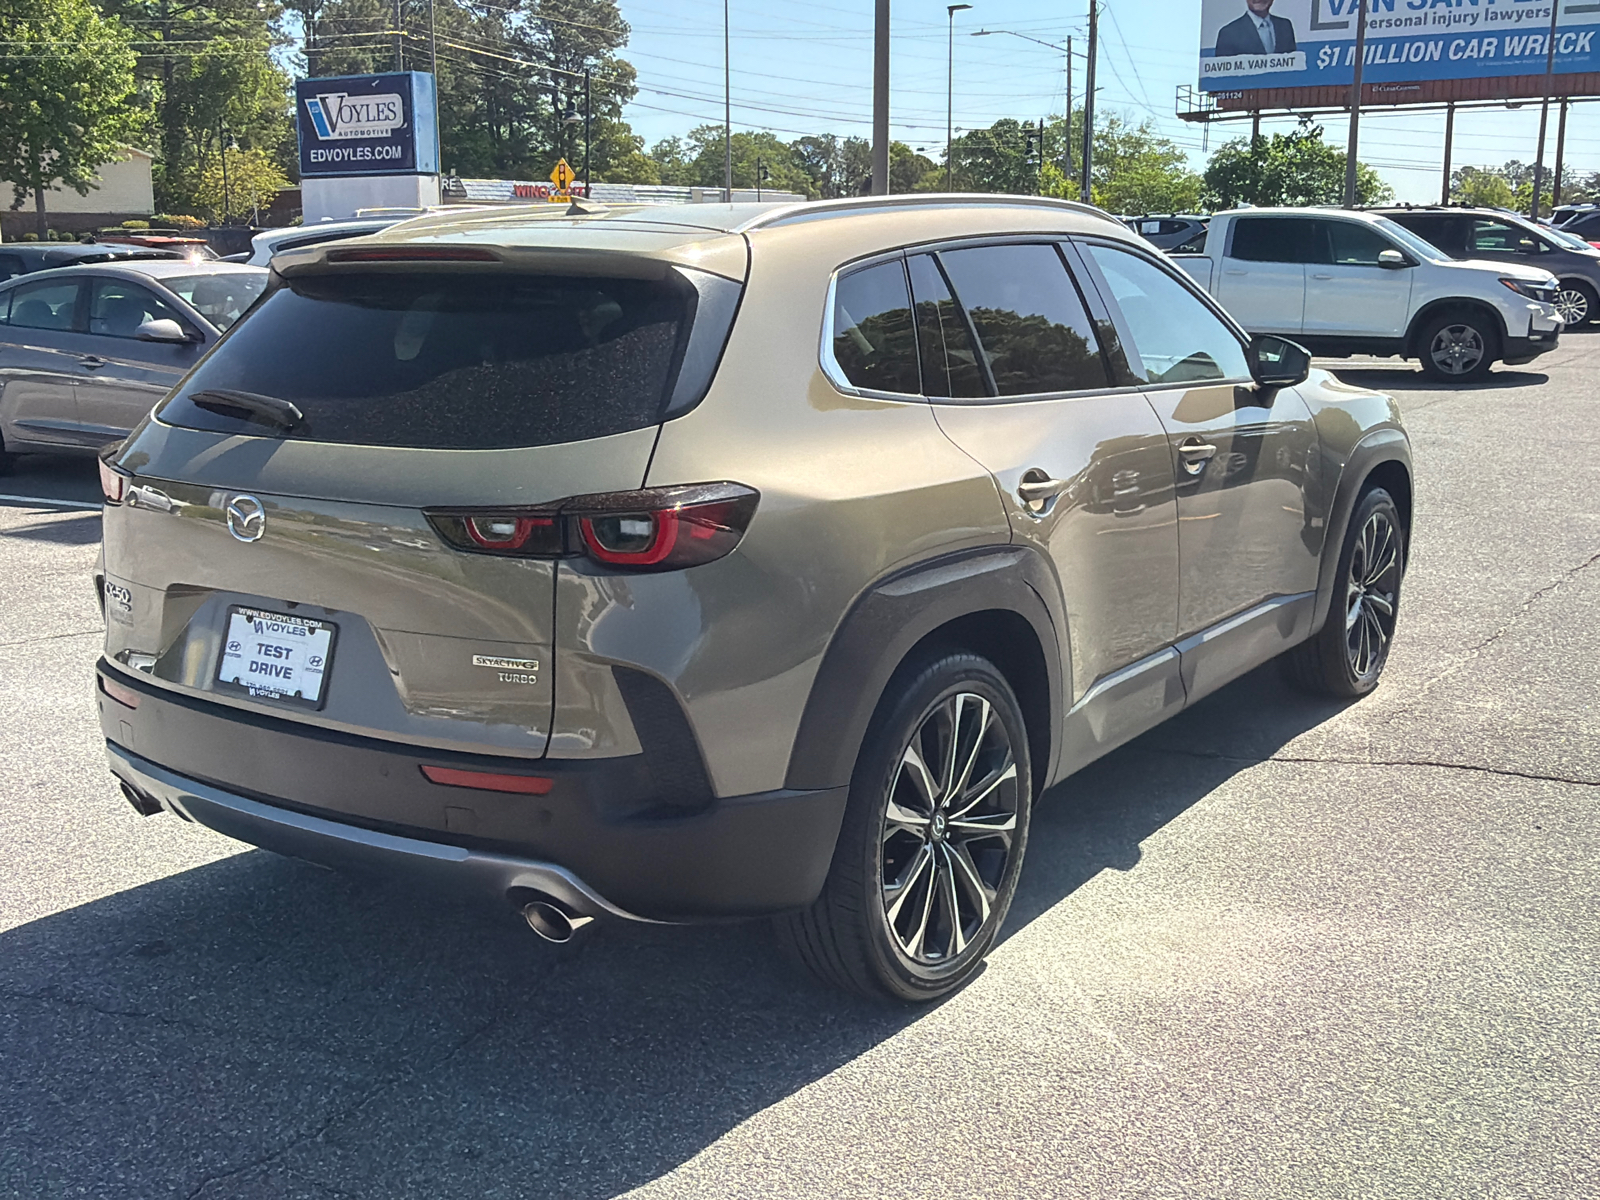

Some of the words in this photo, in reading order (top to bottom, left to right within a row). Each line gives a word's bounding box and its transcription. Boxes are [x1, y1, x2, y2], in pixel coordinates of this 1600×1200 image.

[1432, 11, 1479, 27] injury
[1484, 7, 1551, 23] lawyers
[1316, 44, 1341, 70] $1
[1344, 40, 1444, 66] MILLION
[1448, 37, 1498, 61] CAR
[1503, 30, 1596, 57] WRECK
[1204, 61, 1232, 73] DAVID
[1233, 60, 1246, 71] M.
[1247, 59, 1268, 70] VAN
[1269, 57, 1296, 68] SANT
[319, 95, 397, 134] VOYLES
[338, 128, 390, 137] AUTOMOTIVE
[310, 145, 402, 163] EDVOYLES.COM
[513, 185, 549, 199] WING
[238, 607, 323, 629] WWW.EDVOYLES.COM
[266, 621, 306, 637] VOYLES
[257, 642, 293, 660] TEST
[248, 660, 293, 680] DRIVE
[497, 672, 537, 684] TURBO
